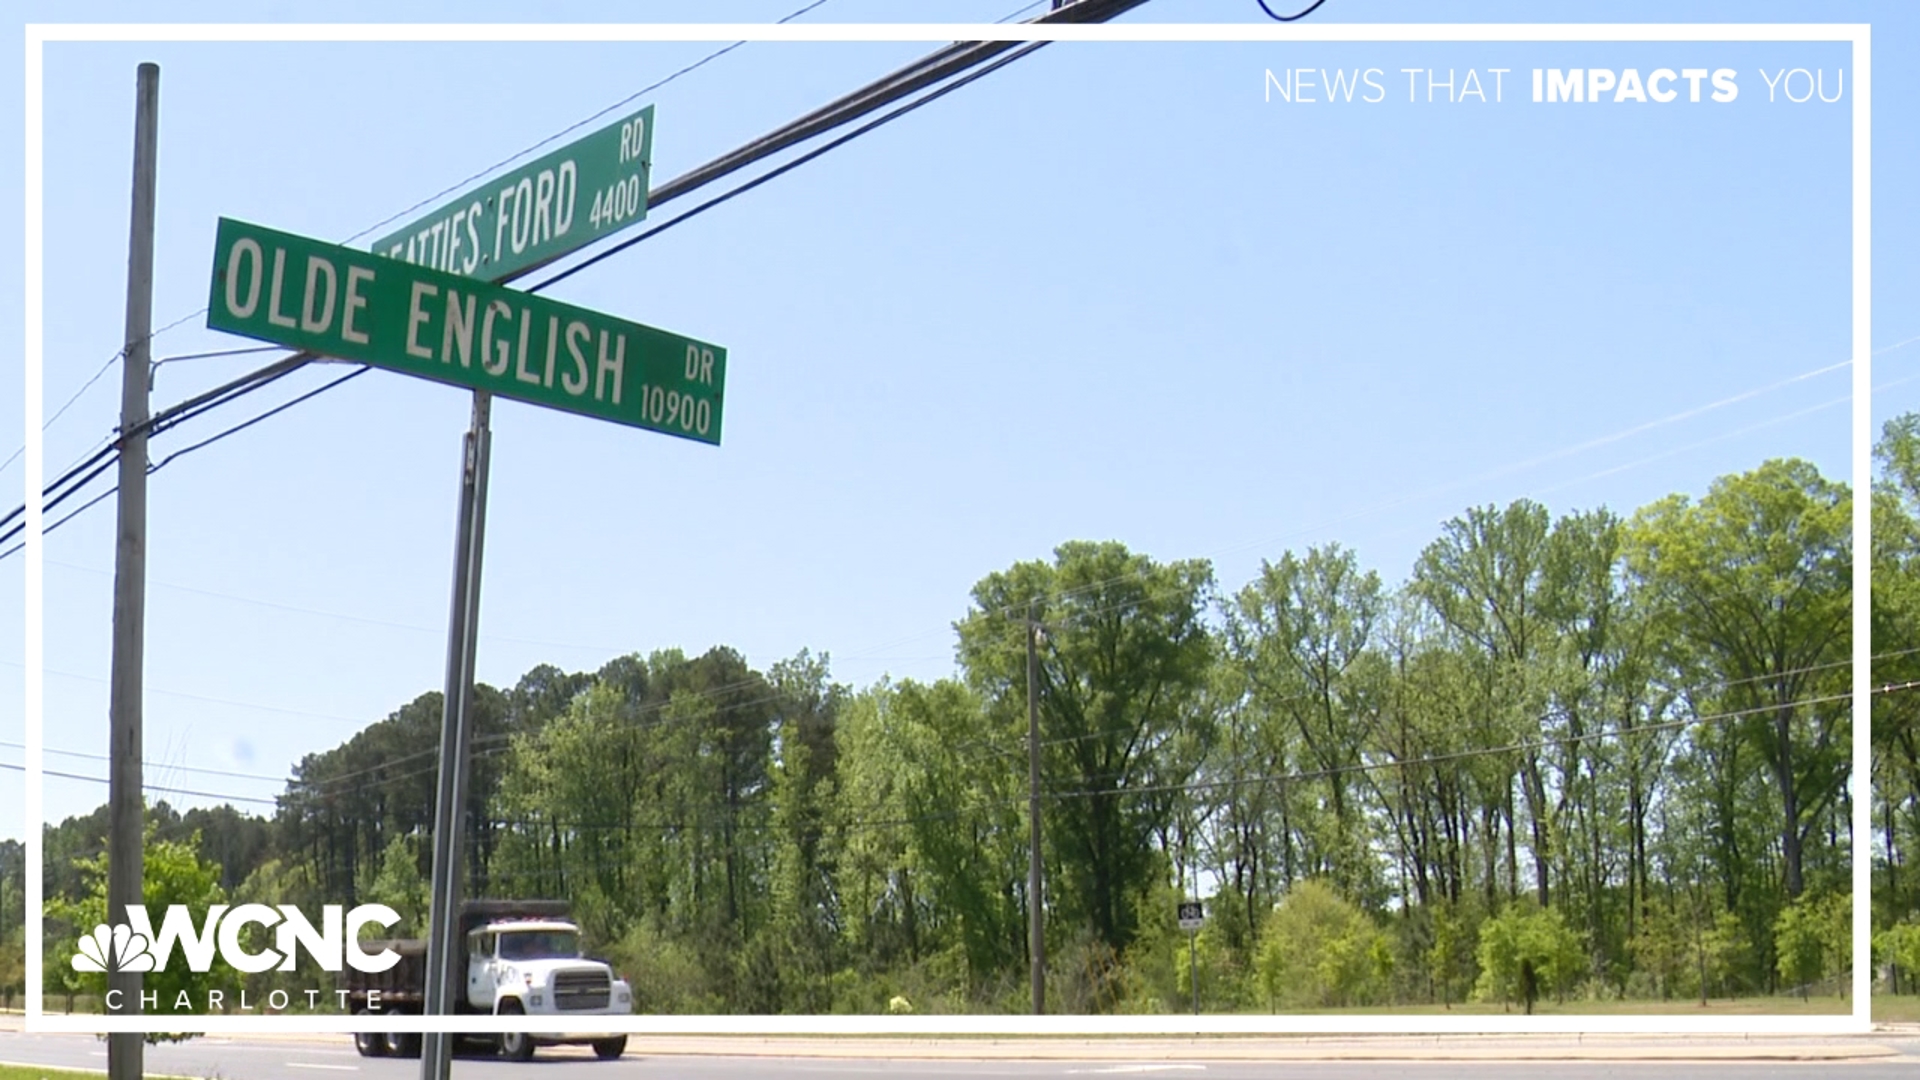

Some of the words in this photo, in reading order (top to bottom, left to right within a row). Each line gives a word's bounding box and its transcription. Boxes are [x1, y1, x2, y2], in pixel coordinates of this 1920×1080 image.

[620, 116, 644, 164] RD
[378, 200, 483, 276] ATTIES
[493, 159, 577, 262] FORD
[589, 174, 640, 230] 4400
[225, 237, 375, 345] OLDE
[406, 280, 627, 405] ENGLISH
[685, 344, 714, 385] DR
[641, 385, 711, 436] 10900
